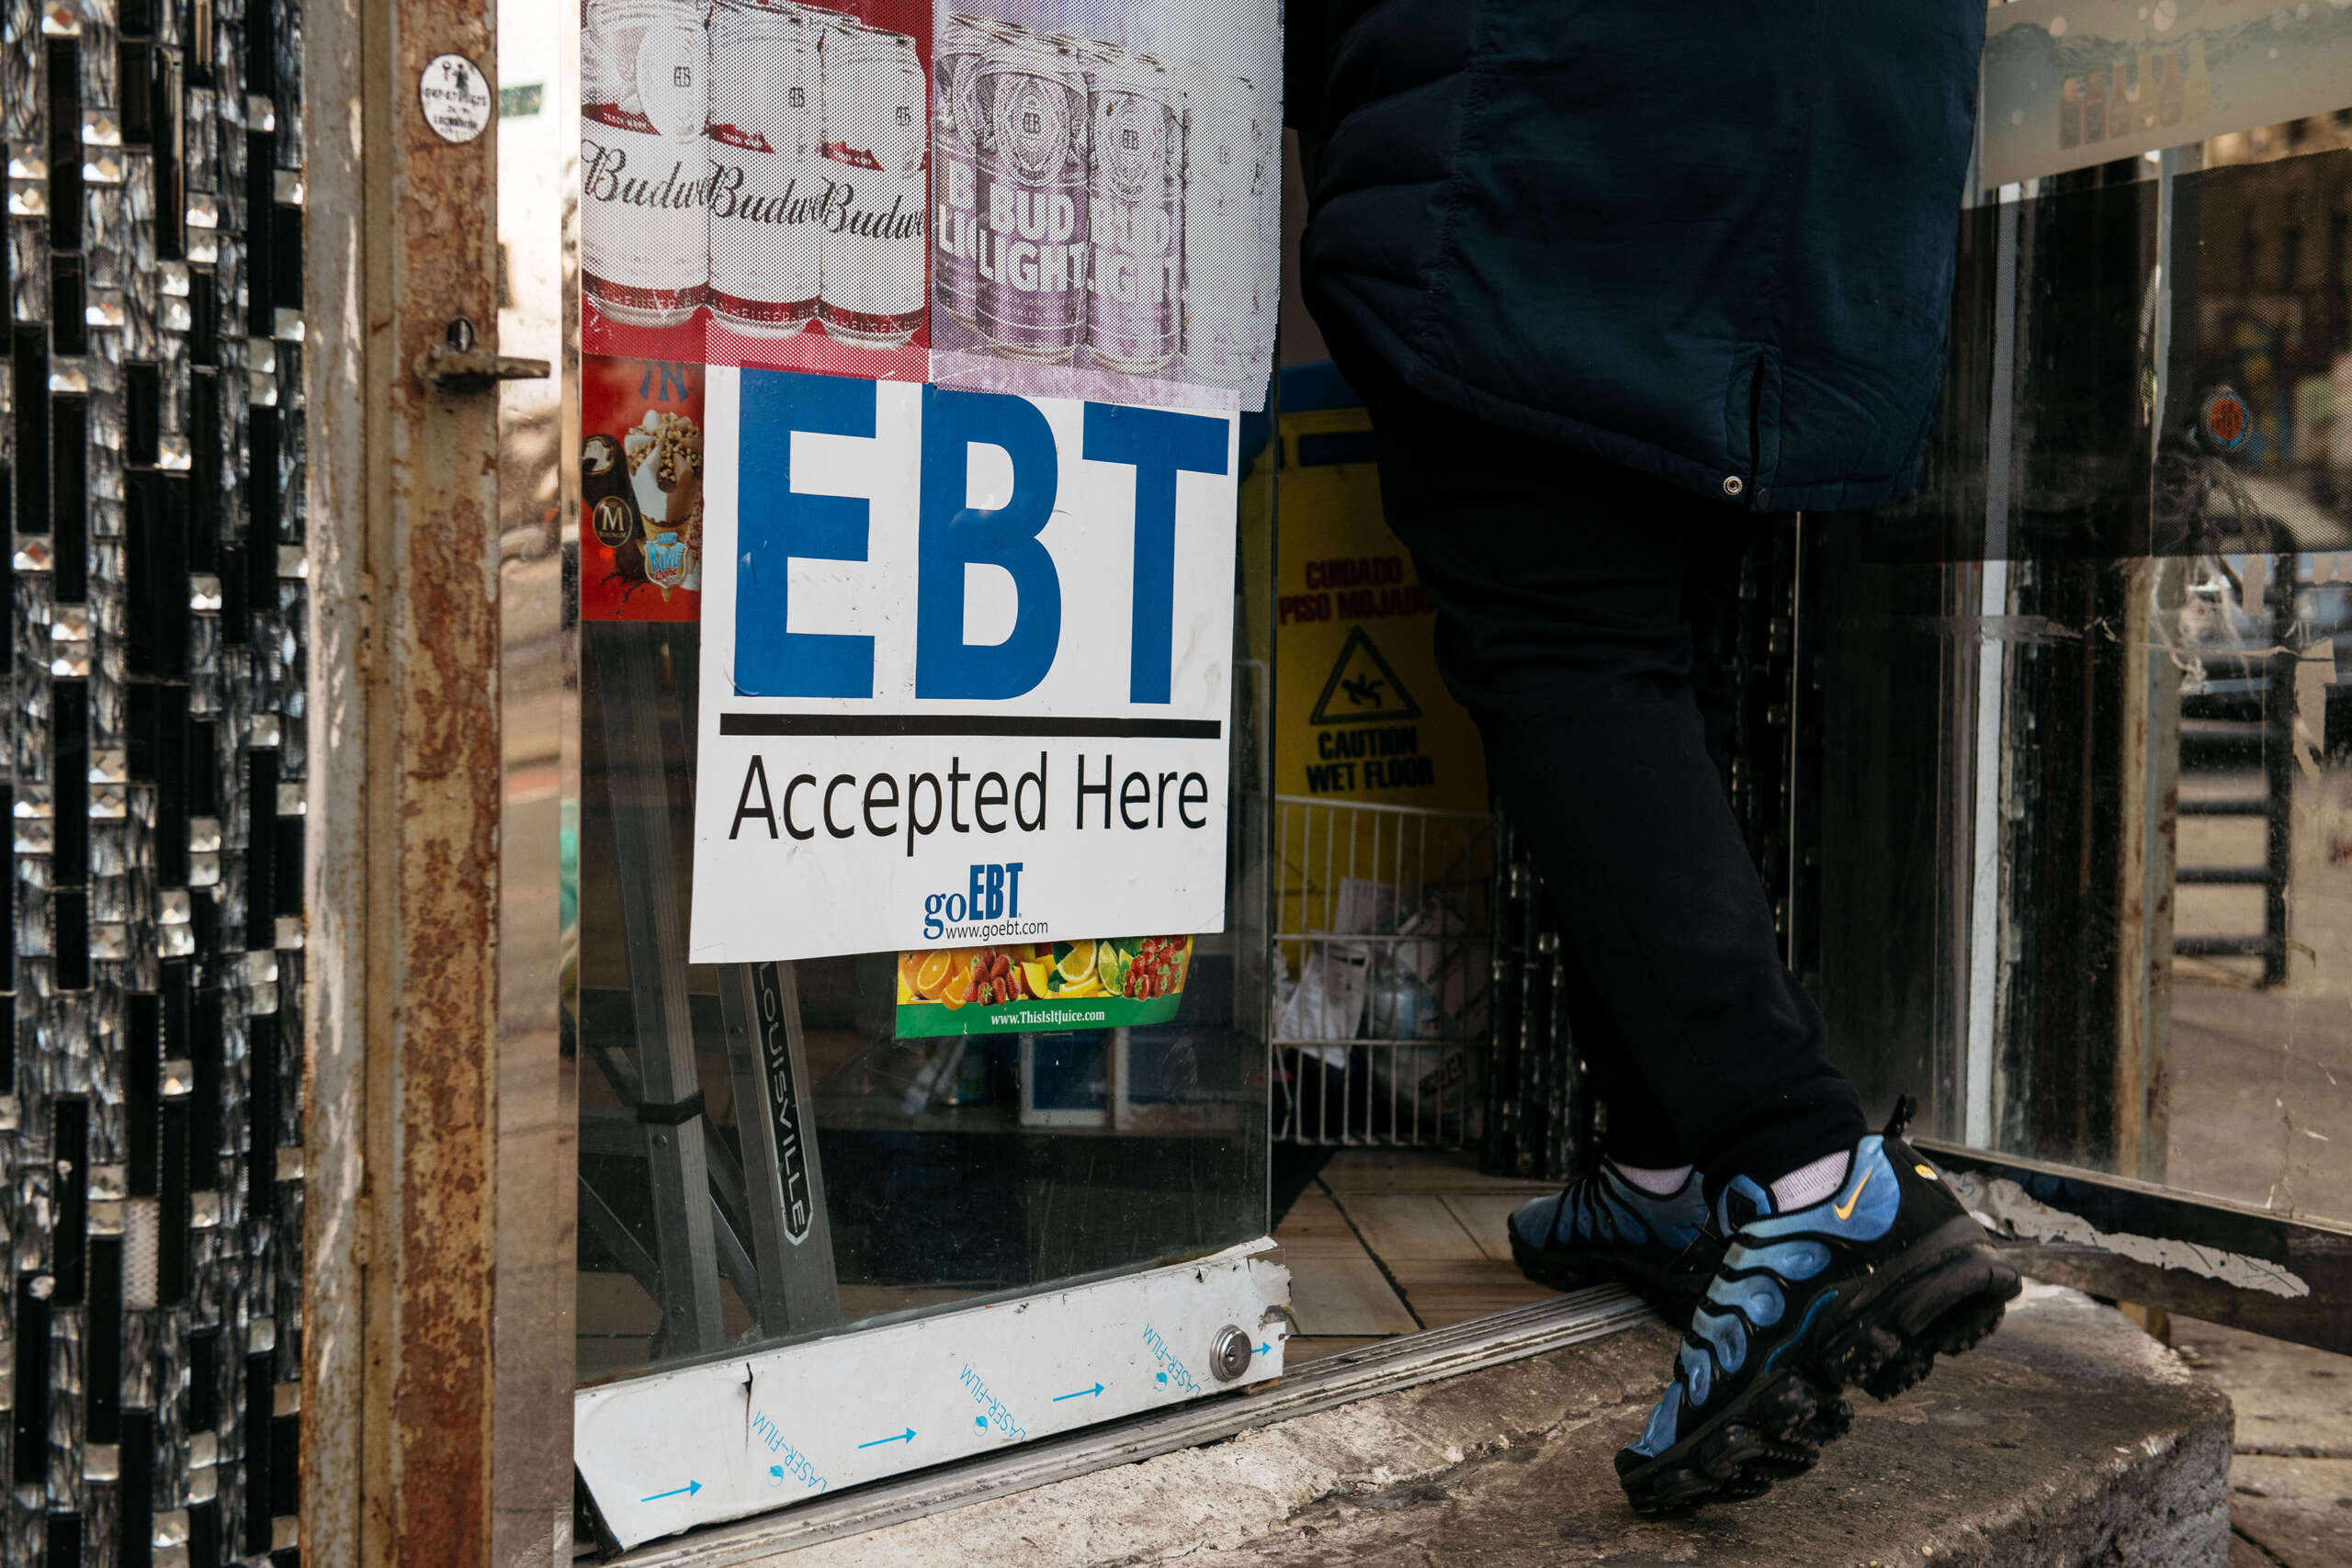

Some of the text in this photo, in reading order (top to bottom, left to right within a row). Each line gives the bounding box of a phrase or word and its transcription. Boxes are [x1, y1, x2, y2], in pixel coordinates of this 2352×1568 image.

[989, 182, 1075, 243] BUD
[979, 229, 1087, 292] LIGHT
[734, 372, 1229, 705] EBT
[1306, 556, 1403, 590] CUIDADO
[1278, 592, 1331, 626] PISO
[1317, 726, 1418, 761] CAUTION
[729, 751, 1209, 857] Accepted Here
[1306, 756, 1434, 794] WET FLOOR
[945, 919, 1048, 942] www.goebt.com
[990, 1009, 1105, 1028] www.ThisIsItJuice.com
[759, 962, 805, 1234] LOUISVILLE
[1142, 1323, 1202, 1396] LASER-FILM
[958, 1363, 1026, 1442] LASER-FILM
[752, 1410, 828, 1494] LASER-FILM
